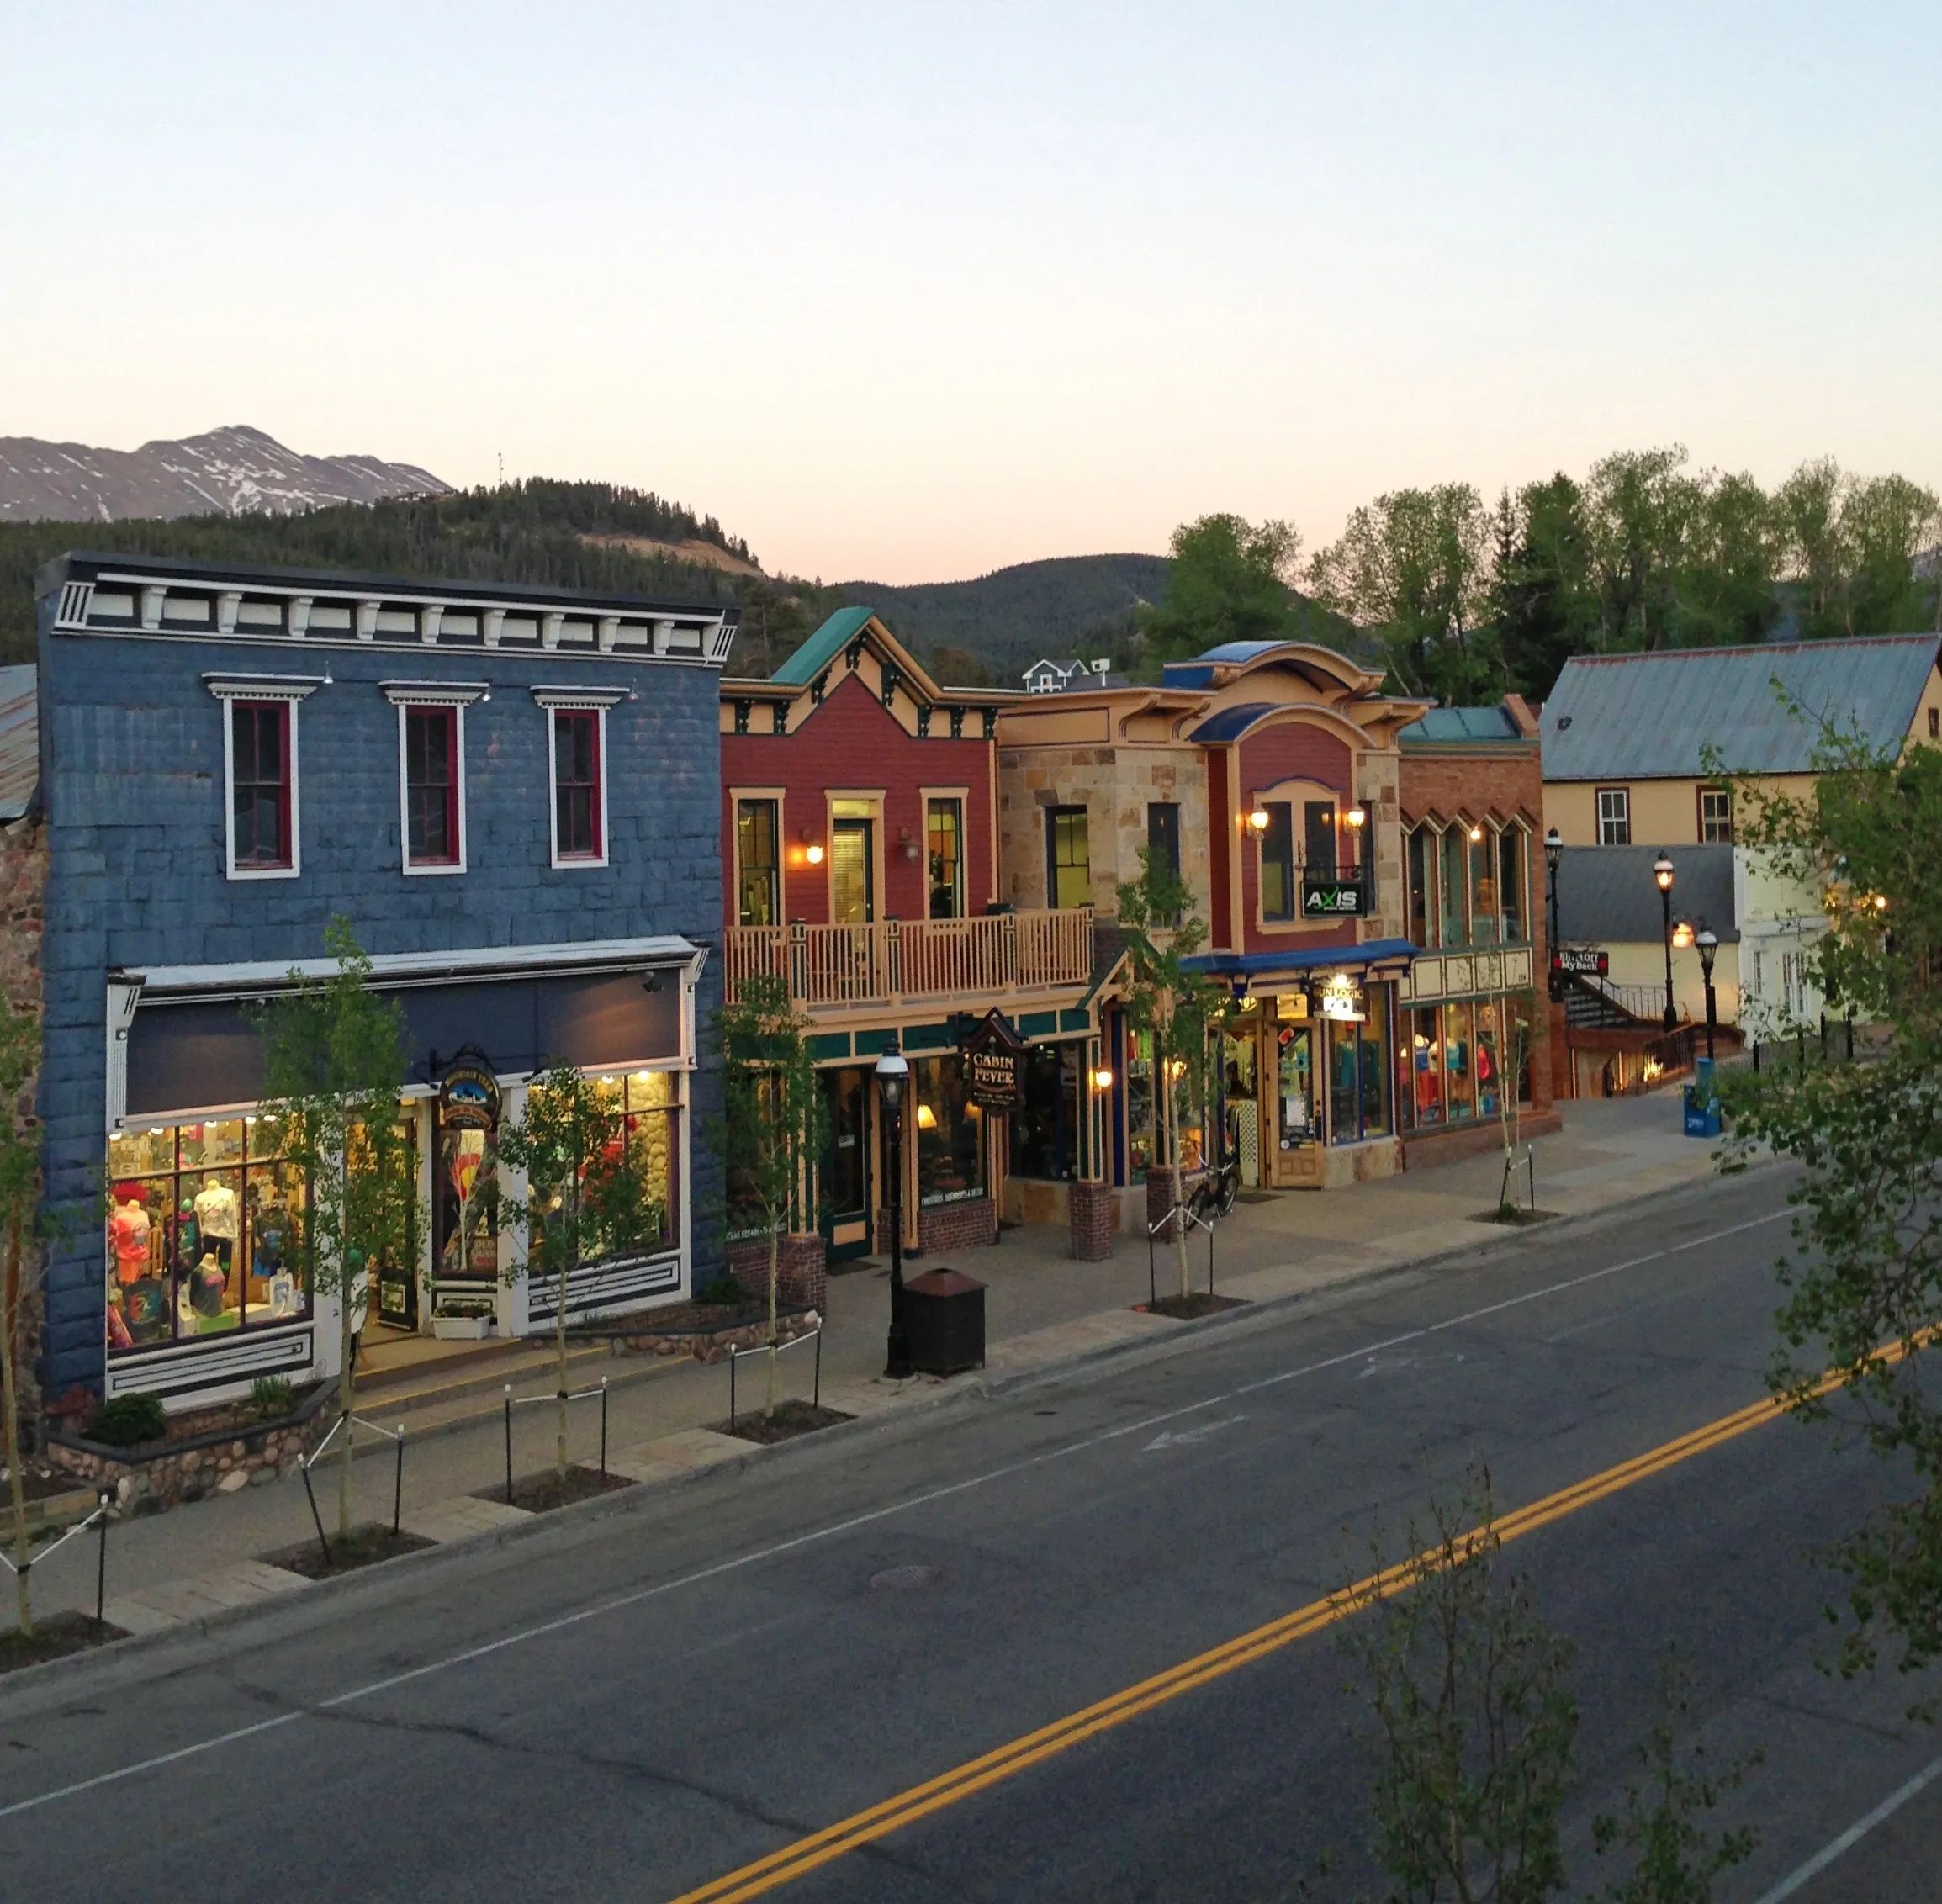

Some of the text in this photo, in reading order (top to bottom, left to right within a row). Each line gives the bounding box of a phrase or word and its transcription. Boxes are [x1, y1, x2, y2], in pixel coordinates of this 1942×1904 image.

[1306, 886, 1357, 907] AXIS
[1575, 961, 1597, 970] Back
[1335, 987, 1363, 1000] LOGIC
[973, 1053, 1014, 1069] CABIN
[975, 1068, 1014, 1084] FEVER
